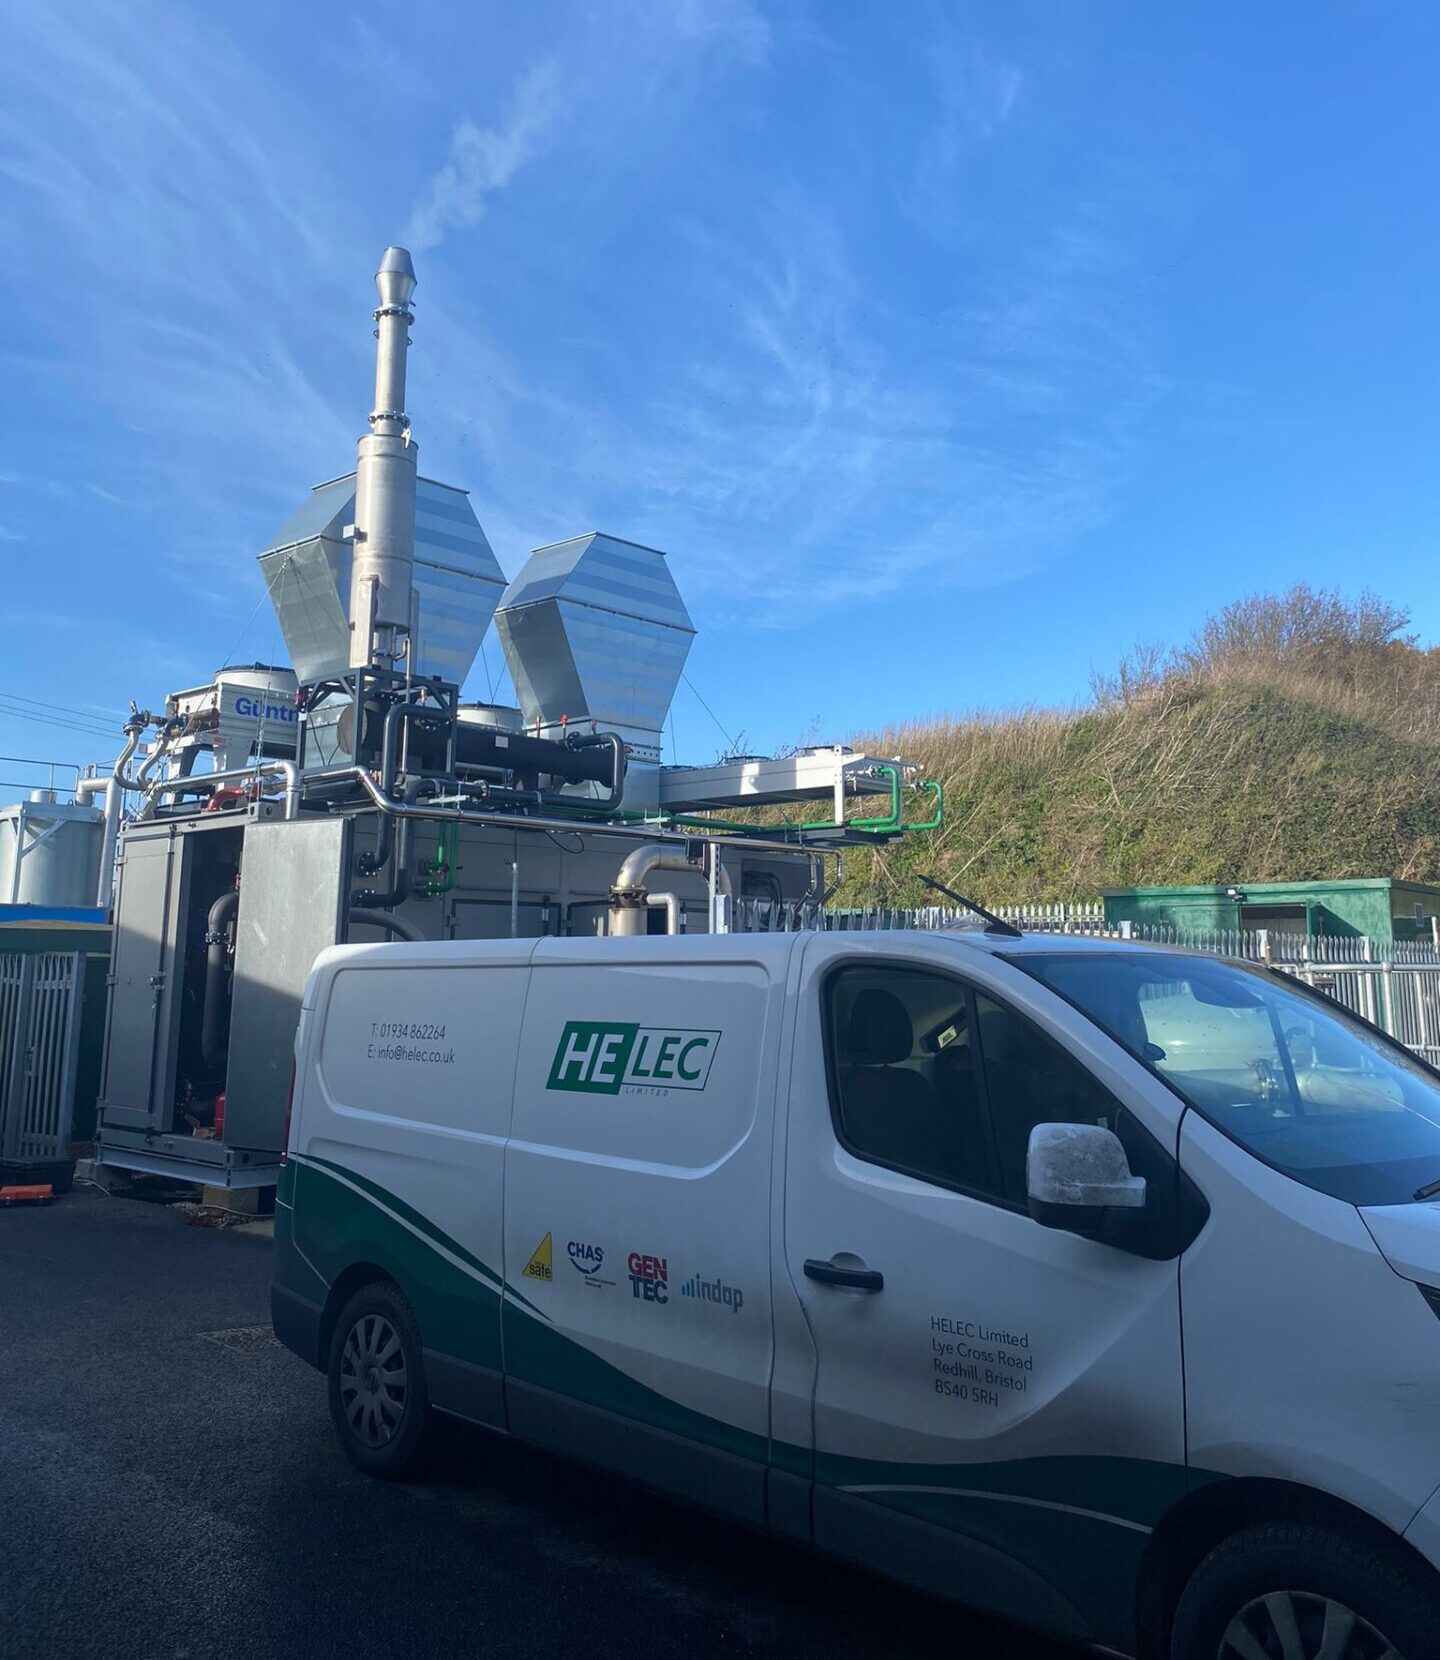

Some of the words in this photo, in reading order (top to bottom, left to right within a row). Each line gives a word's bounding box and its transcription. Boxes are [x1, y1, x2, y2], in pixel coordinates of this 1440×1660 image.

[371, 1022, 379, 1038] T:
[380, 1023, 408, 1039] 01934
[409, 1024, 446, 1040] 862264
[367, 1044, 376, 1058] E:
[377, 1044, 456, 1063] info@helec.co.uk
[557, 1032, 709, 1084] HELEC
[625, 1087, 669, 1097] LIMITED
[567, 1241, 603, 1262] CHAS
[529, 1263, 551, 1279] safe
[628, 1252, 668, 1282] GEN
[629, 1274, 668, 1304] TEC
[931, 1316, 974, 1338] HELEC
[978, 1326, 1029, 1348] Limited
[932, 1338, 953, 1356] Lye
[957, 1342, 994, 1363] Cross
[998, 1350, 1033, 1371] Road
[934, 1358, 982, 1382] Redhill,
[985, 1369, 1026, 1392] Bristol
[935, 1379, 968, 1400] BS40
[972, 1387, 998, 1407] 5RH
